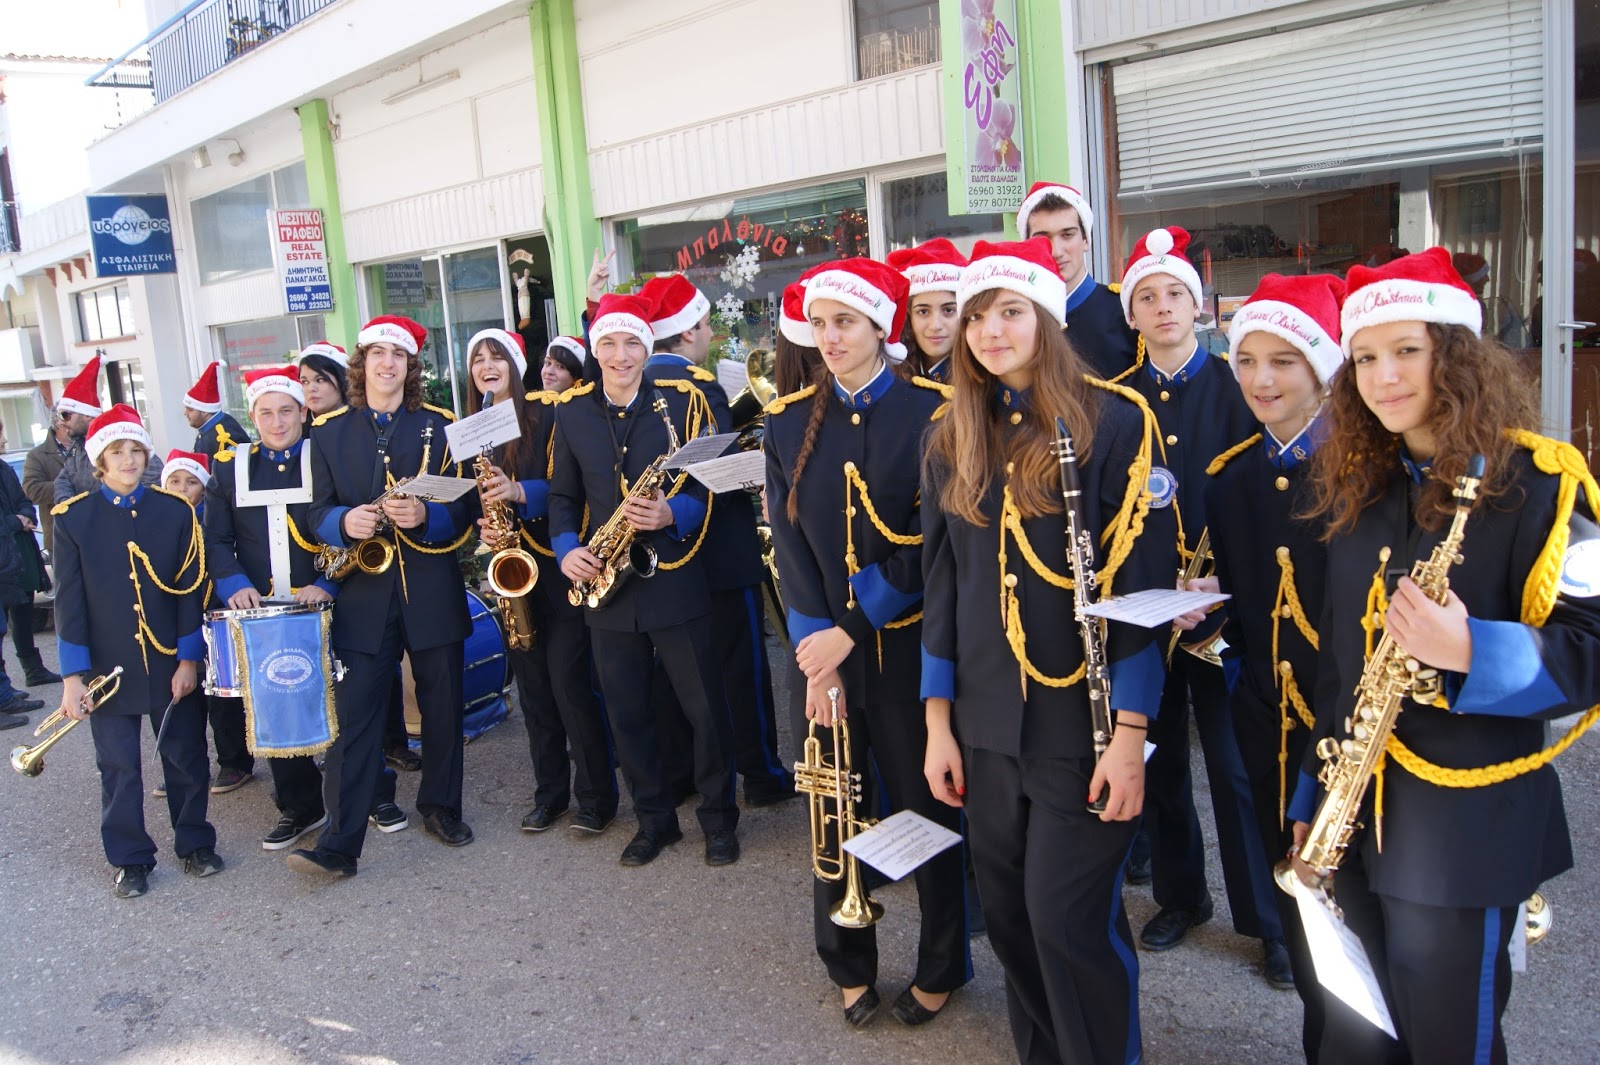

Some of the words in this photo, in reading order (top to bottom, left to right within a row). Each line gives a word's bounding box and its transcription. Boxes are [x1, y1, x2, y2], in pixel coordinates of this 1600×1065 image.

[968, 186, 994, 196] 26960
[996, 185, 1022, 195] 31922
[991, 198, 1023, 207] 807125
[277, 211, 320, 226] ΜΕΣΙΤΙΚΟ
[93, 219, 171, 234] υδρόγειος
[280, 226, 321, 241] ΓΡΑΦΕΙΟ
[291, 243, 316, 251] REAL
[677, 214, 788, 271] Μπαλόνια
[101, 253, 172, 265] ΑΣΦΑΛΙΣΤΙΚΗ
[286, 252, 323, 261] ESTATE
[117, 263, 159, 272] ΕΤΑΙΡΕΙΑ
[287, 266, 324, 275] ΔΗΜΗΤΡΗΣ
[285, 274, 327, 284] ΠΑΝΑΓΑΚΟΣ
[288, 293, 308, 302] 26960
[1363, 288, 1423, 314] Christmas
